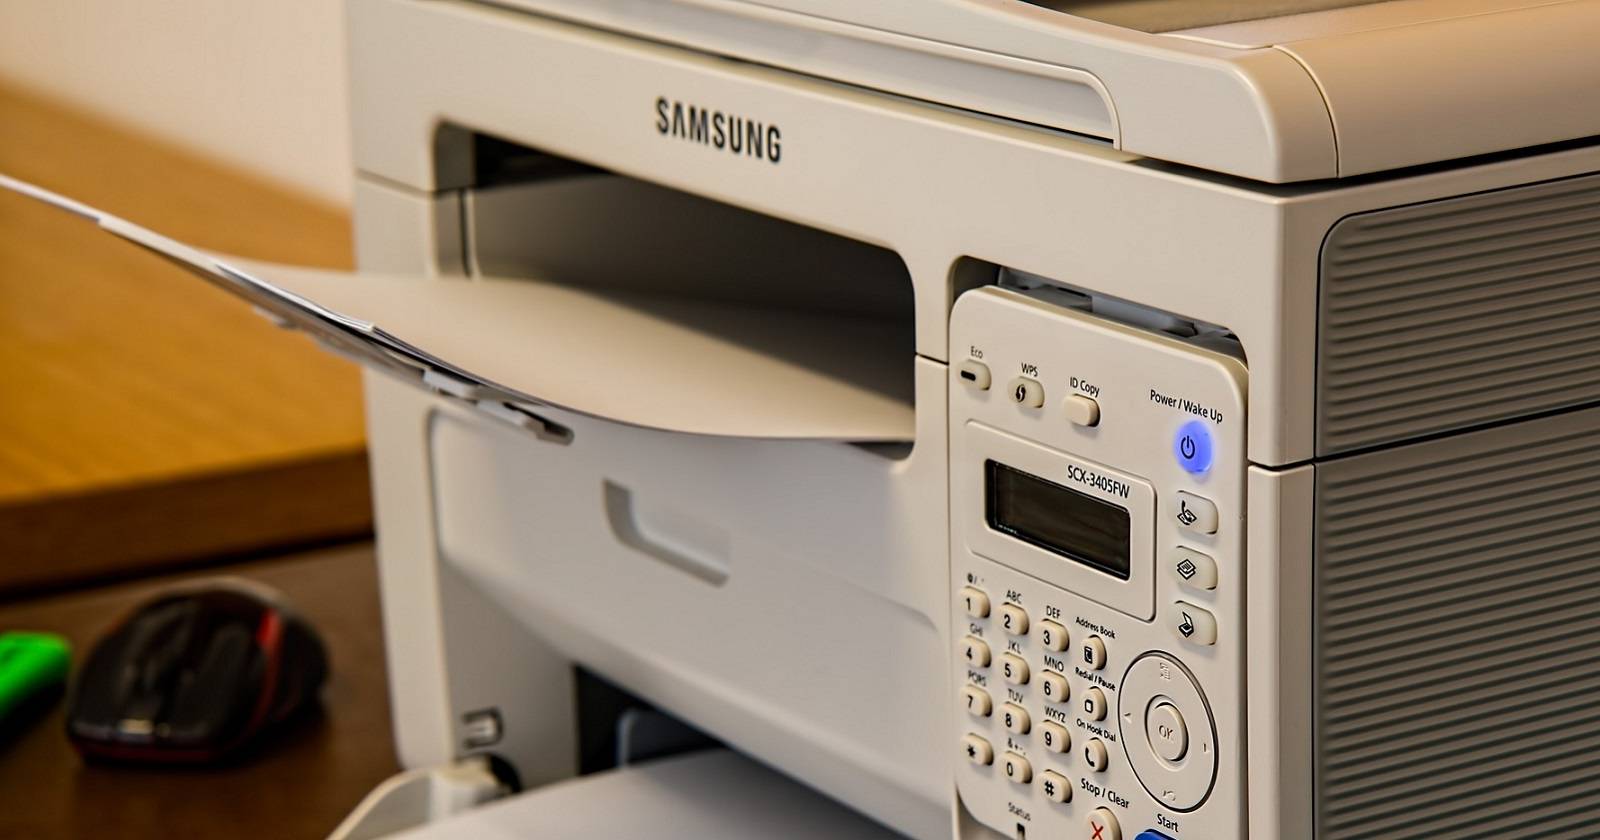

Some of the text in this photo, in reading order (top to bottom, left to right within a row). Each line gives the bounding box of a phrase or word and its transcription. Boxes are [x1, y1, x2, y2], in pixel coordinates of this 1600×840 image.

[655, 96, 781, 163] SAMSUNG
[970, 345, 983, 359] Eco
[1021, 362, 1038, 377] WPS
[1069, 376, 1100, 398] ID Copy
[1150, 389, 1177, 408] Power
[1183, 399, 1208, 418] Wake
[1210, 408, 1223, 424] Up
[1067, 464, 1130, 499] SCX-3405FW
[966, 597, 971, 611] 1
[1006, 589, 1022, 604] ABC
[1046, 605, 1061, 619] DEF
[1004, 613, 1011, 629] 2
[1075, 616, 1116, 639] Address Book
[1043, 629, 1051, 646] 3
[966, 646, 973, 661] 4
[1004, 662, 1011, 678] 5
[1043, 655, 1065, 672] MNO
[1075, 666, 1094, 682] Redial
[1098, 676, 1116, 692] Pause
[1007, 688, 1024, 703] TUV
[1043, 681, 1051, 696] 6
[967, 694, 974, 708] 7
[1005, 713, 1012, 728] 8
[1044, 706, 1066, 723] WXYZ
[1044, 731, 1052, 746] 9
[1076, 718, 1116, 743] On Hook Dial
[1044, 780, 1055, 797] #
[1080, 777, 1101, 798] Stop
[1107, 790, 1130, 809] Clear
[1157, 813, 1179, 833] Start
